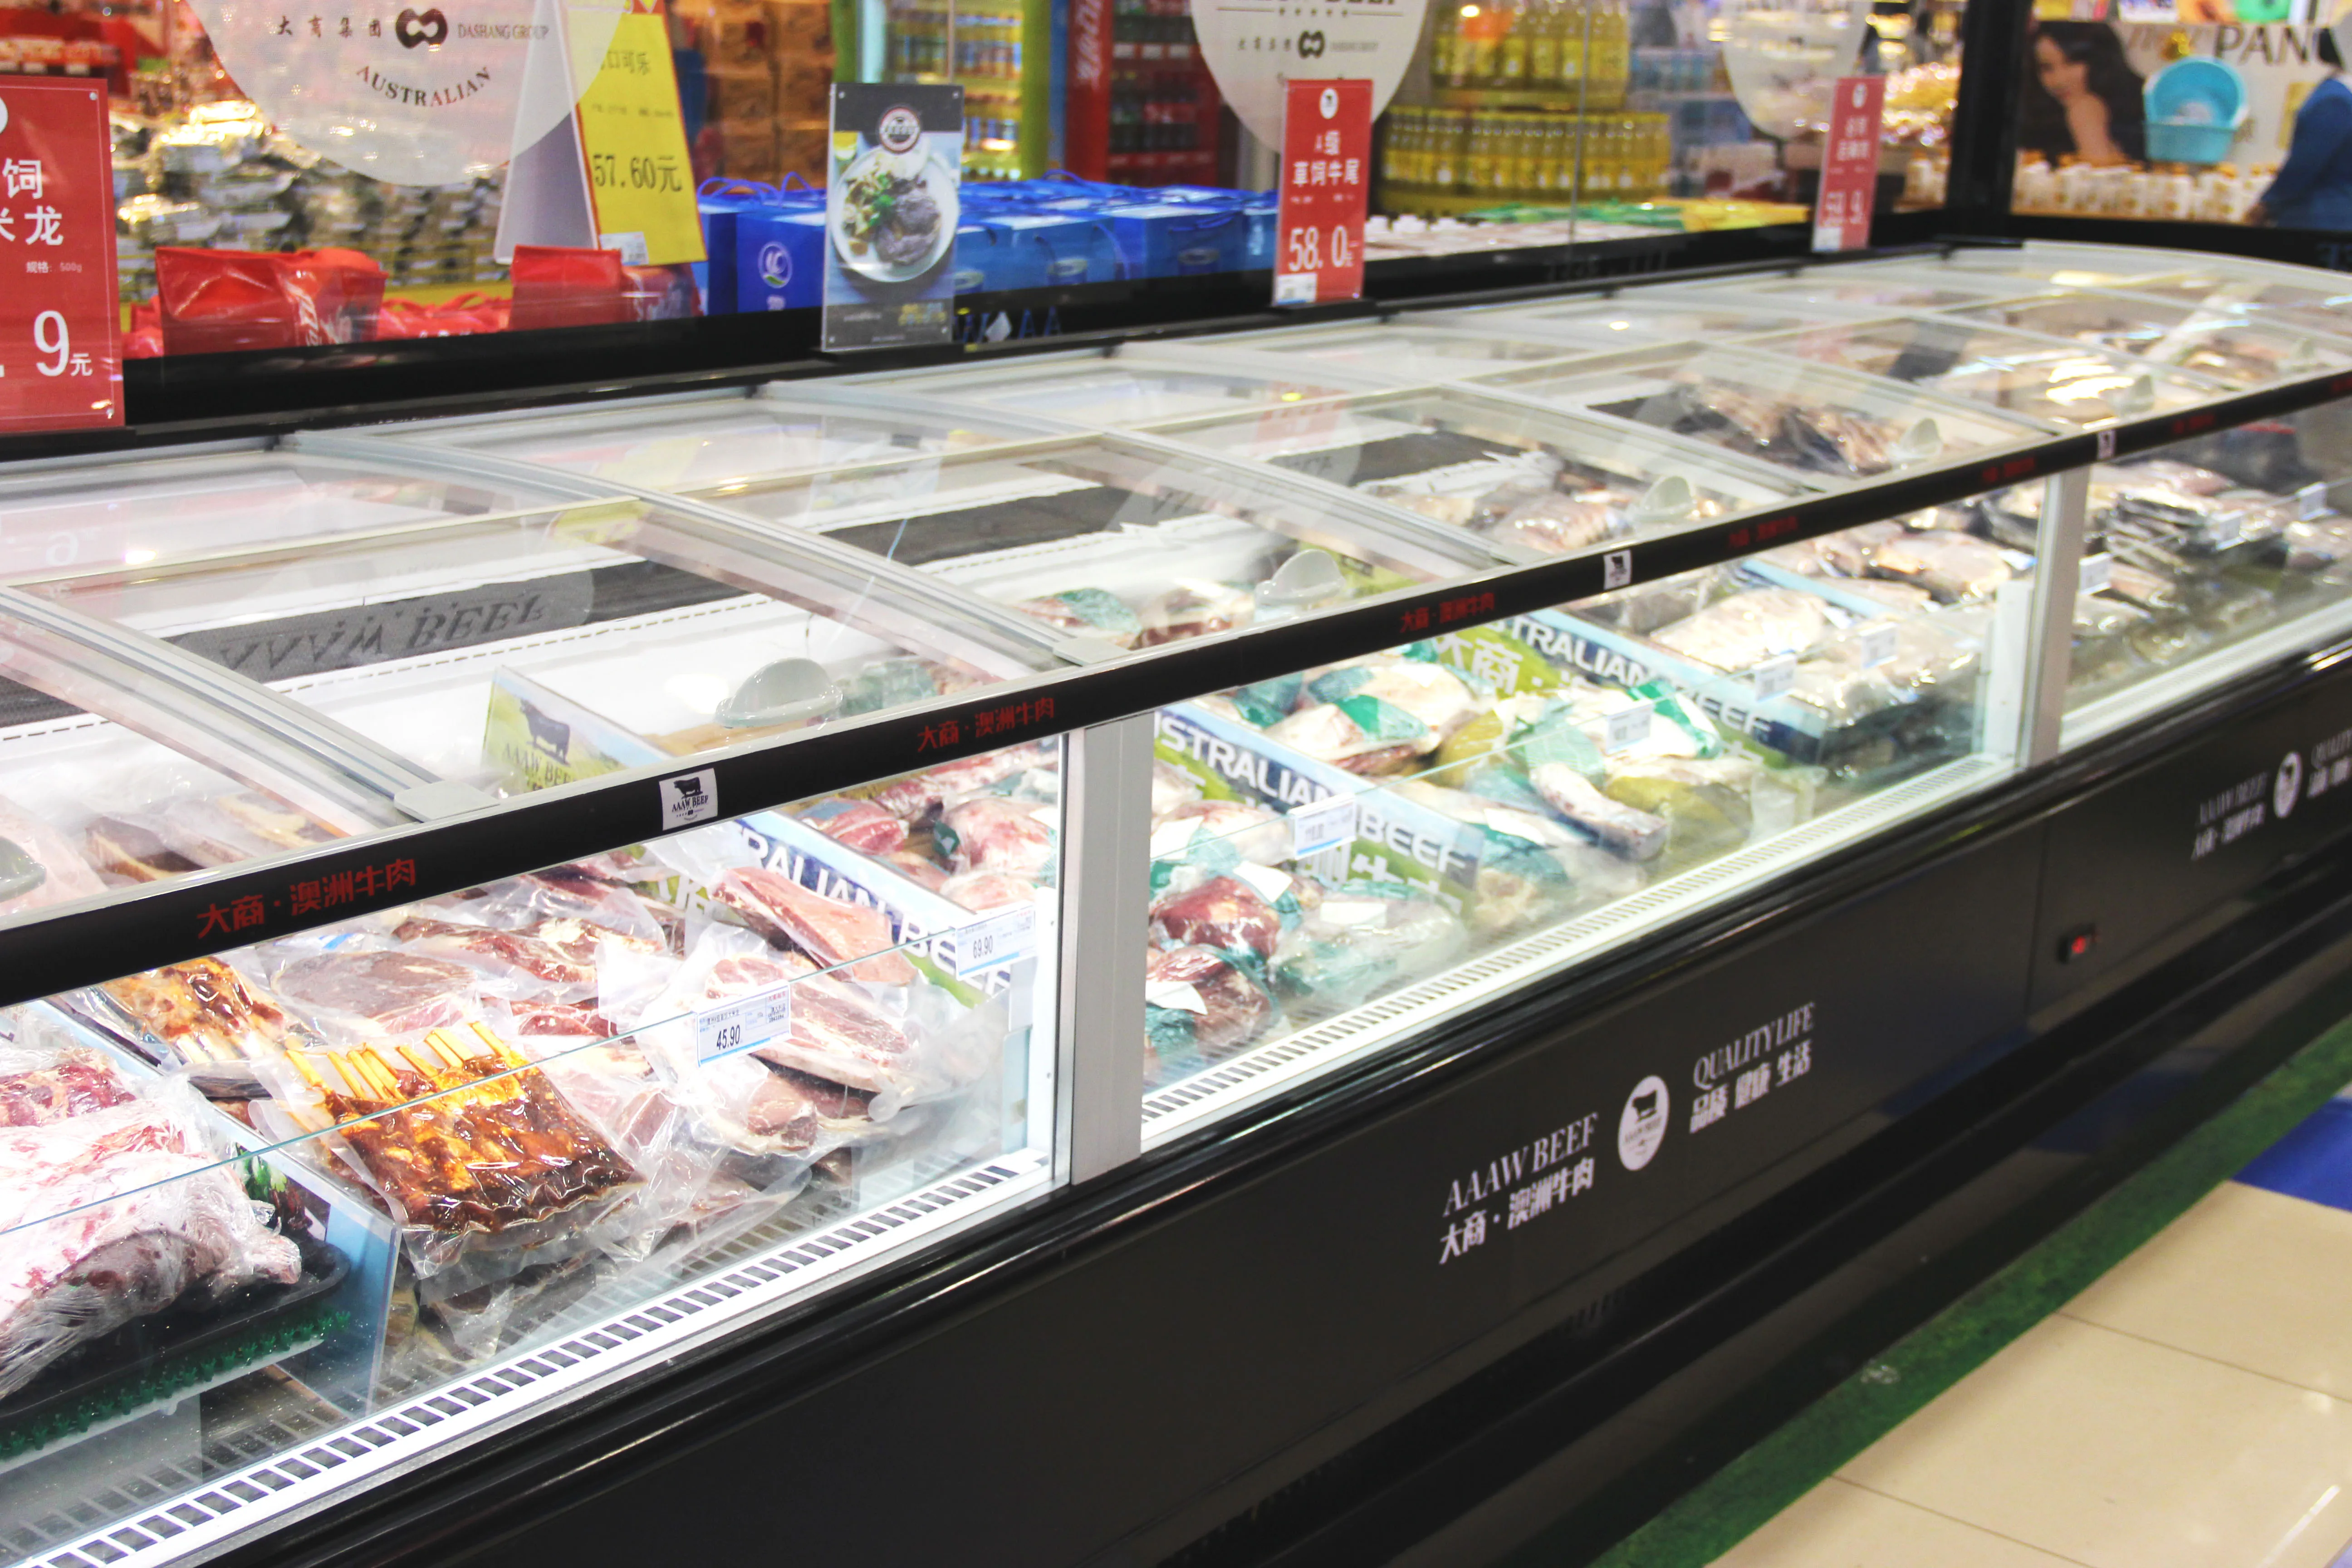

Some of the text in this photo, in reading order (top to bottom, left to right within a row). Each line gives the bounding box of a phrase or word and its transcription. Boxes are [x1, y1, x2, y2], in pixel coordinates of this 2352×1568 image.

[458, 24, 549, 40] DASHANG GROUP
[357, 65, 490, 107] AUSTRALIAN
[3, 158, 43, 200] 饲
[593, 154, 683, 193] 57.60元
[672, 795, 708, 812] AAAW BEEF
[1358, 808, 1466, 873] BEEF
[196, 858, 416, 940] 大商·澳洲牛肉
[973, 935, 993, 959] 69.90
[716, 1024, 740, 1050] 45.90
[1693, 1001, 1816, 1090] QUALITY LIFE
[1775, 1039, 1812, 1087] 生活
[1442, 1146, 1529, 1218] AAAW
[1532, 1112, 1599, 1173] BEEF
